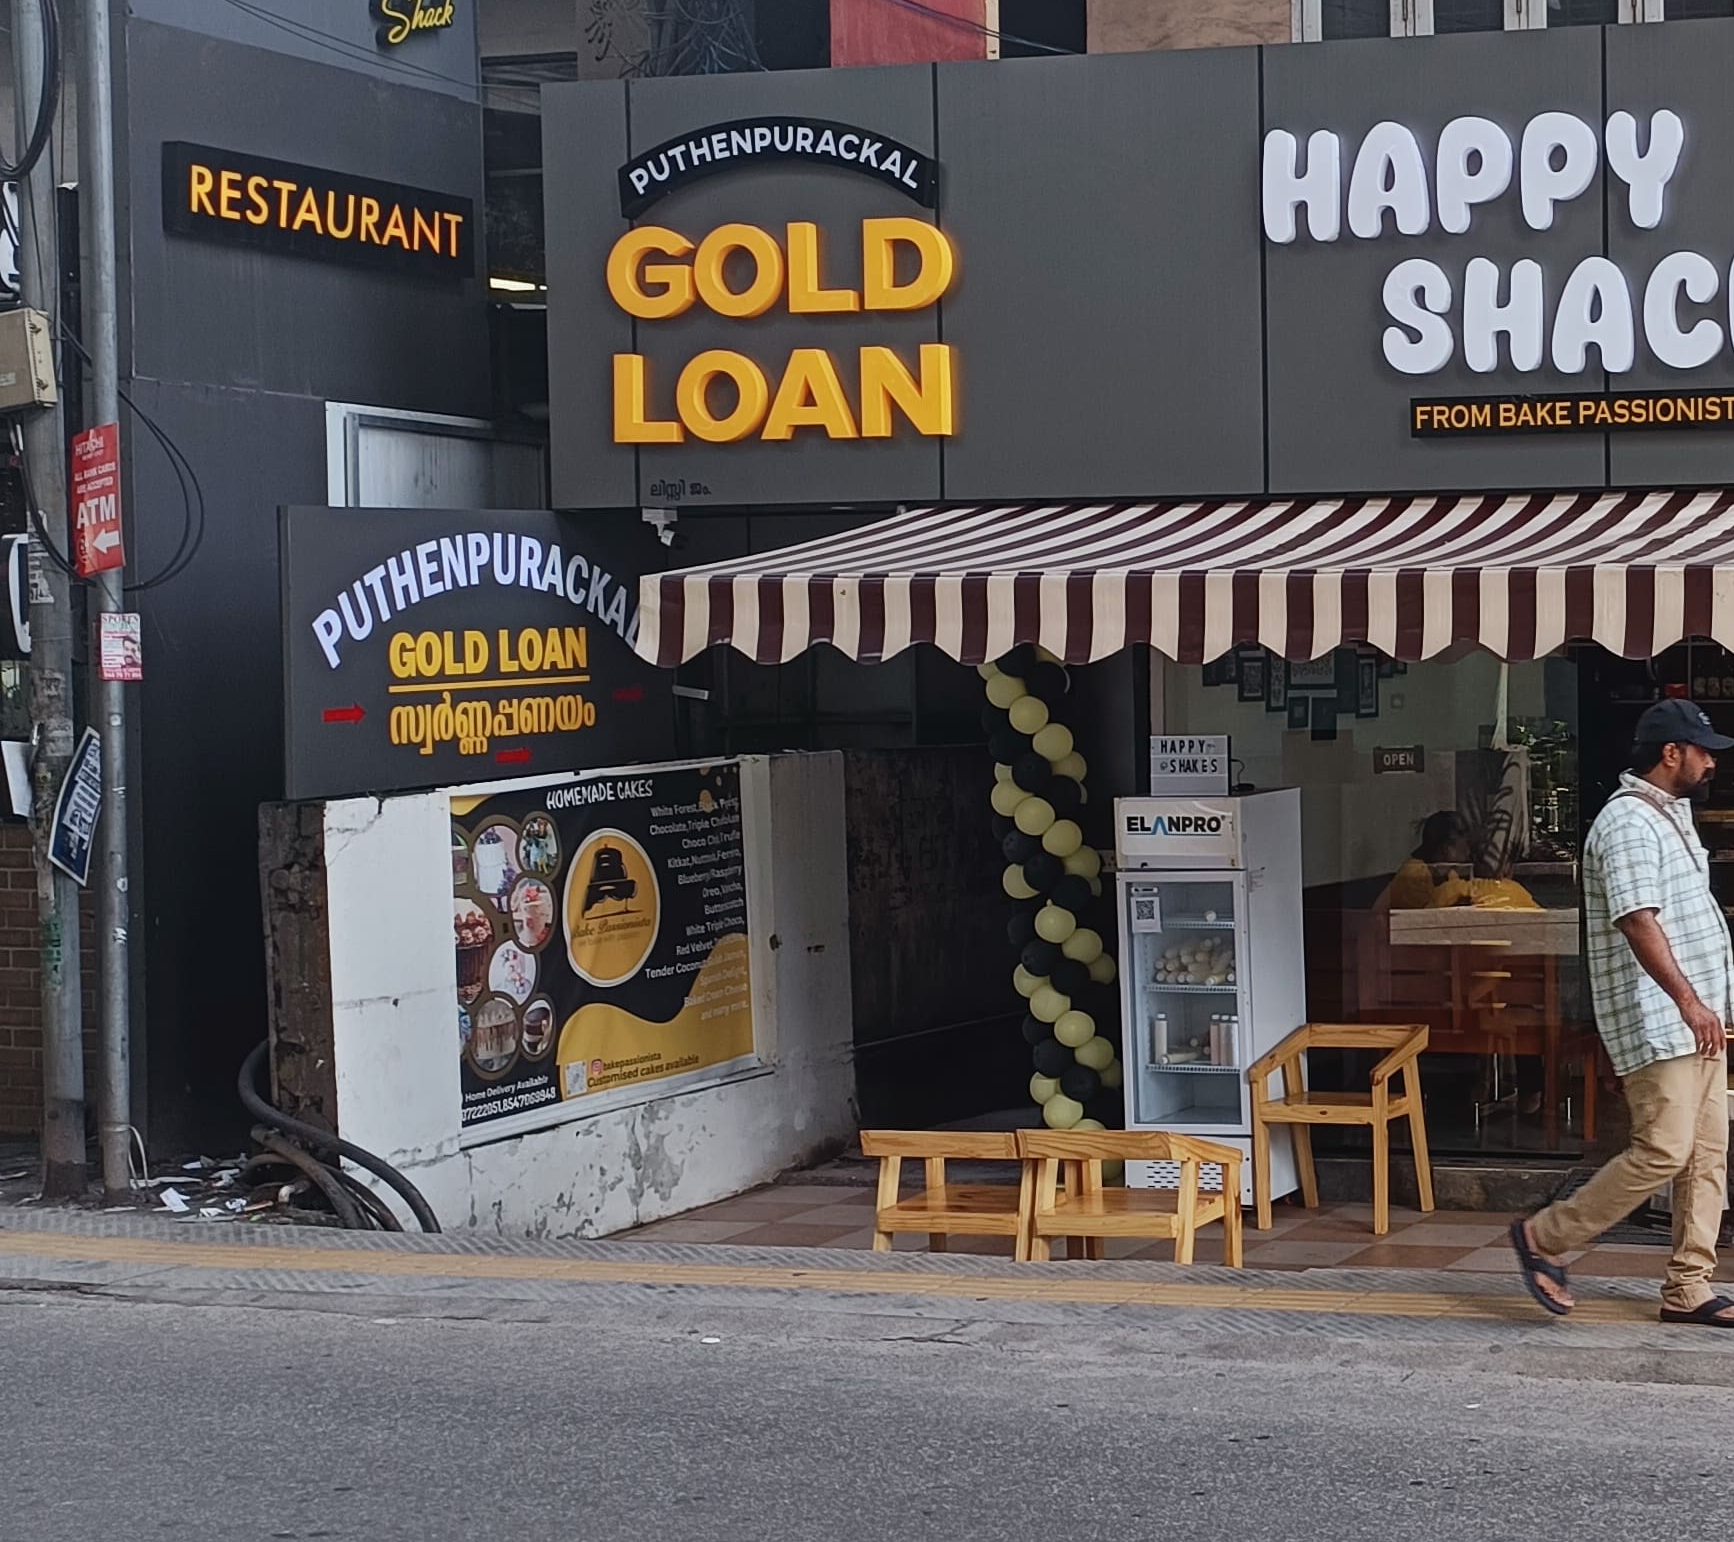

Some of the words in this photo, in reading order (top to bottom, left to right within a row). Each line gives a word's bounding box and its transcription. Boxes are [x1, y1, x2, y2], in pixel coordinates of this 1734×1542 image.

[629, 126, 919, 196] PUTHENPURACKAL
[1262, 109, 1685, 244] HAPPY
[190, 164, 463, 258] RESTAURANT
[606, 217, 953, 319] GOLD
[613, 343, 953, 443] LOAN
[1415, 405, 1492, 429] FROM
[1499, 402, 1572, 427] BAKE
[77, 493, 116, 529] ATM
[388, 631, 489, 678] GOLD
[498, 626, 588, 672] LOAN
[1160, 739, 1206, 753] HAPPY
[1383, 753, 1414, 766] OPEN
[1170, 759, 1218, 773] SHAKES
[546, 781, 615, 810] HOMEMADE
[617, 779, 653, 802] CAKES
[645, 965, 675, 979] Tender
[587, 1067, 638, 1088] Customised
[640, 1062, 664, 1076] cakes
[665, 1055, 699, 1070] available
[465, 1090, 486, 1102] Home
